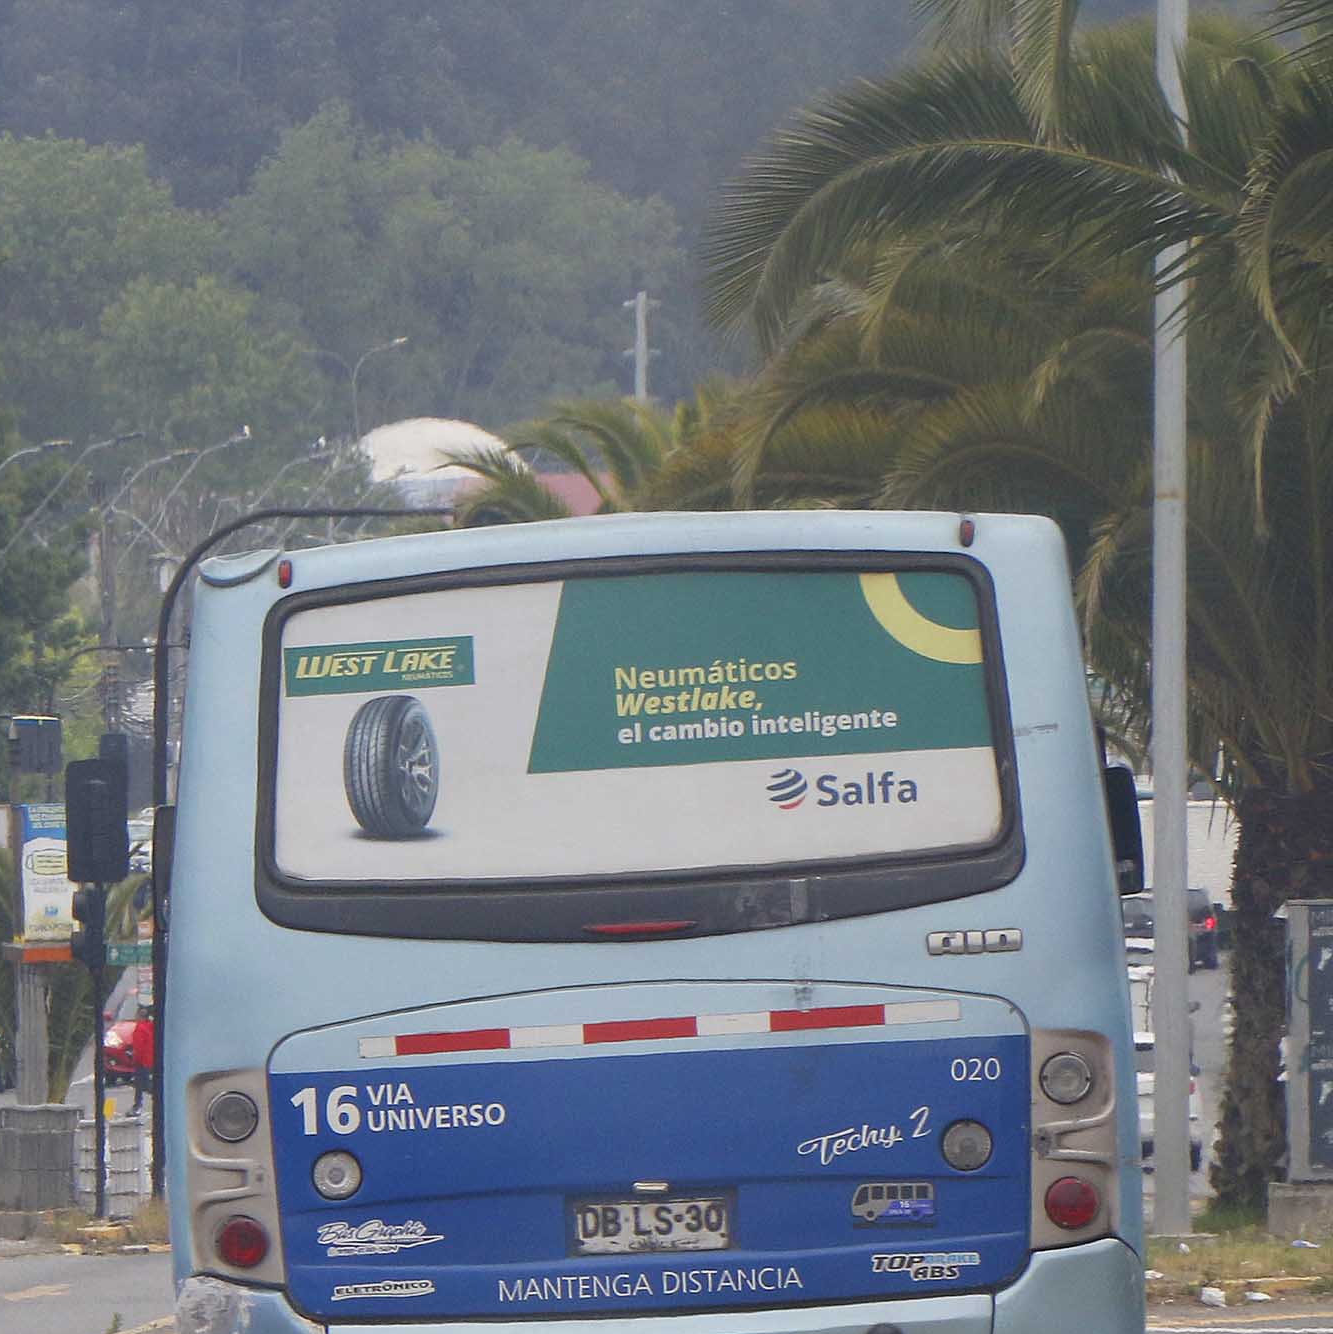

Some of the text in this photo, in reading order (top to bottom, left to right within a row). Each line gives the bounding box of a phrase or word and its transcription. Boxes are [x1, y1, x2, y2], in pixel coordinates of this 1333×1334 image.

[295, 645, 459, 679] WEST LAKE
[614, 658, 798, 691] Neumáticos
[615, 686, 763, 718] Westlake,
[617, 709, 898, 745] el cambio inteligente
[816, 770, 919, 808] Salfa
[950, 1057, 1001, 1082] 020
[290, 1083, 414, 1136] 16 VIA
[367, 1102, 506, 1132] UNIVERSO
[797, 1106, 934, 1166] Techy 2
[498, 1267, 804, 1302] MANTENGA DISTANCIA
[912, 1265, 960, 1281] ABS
